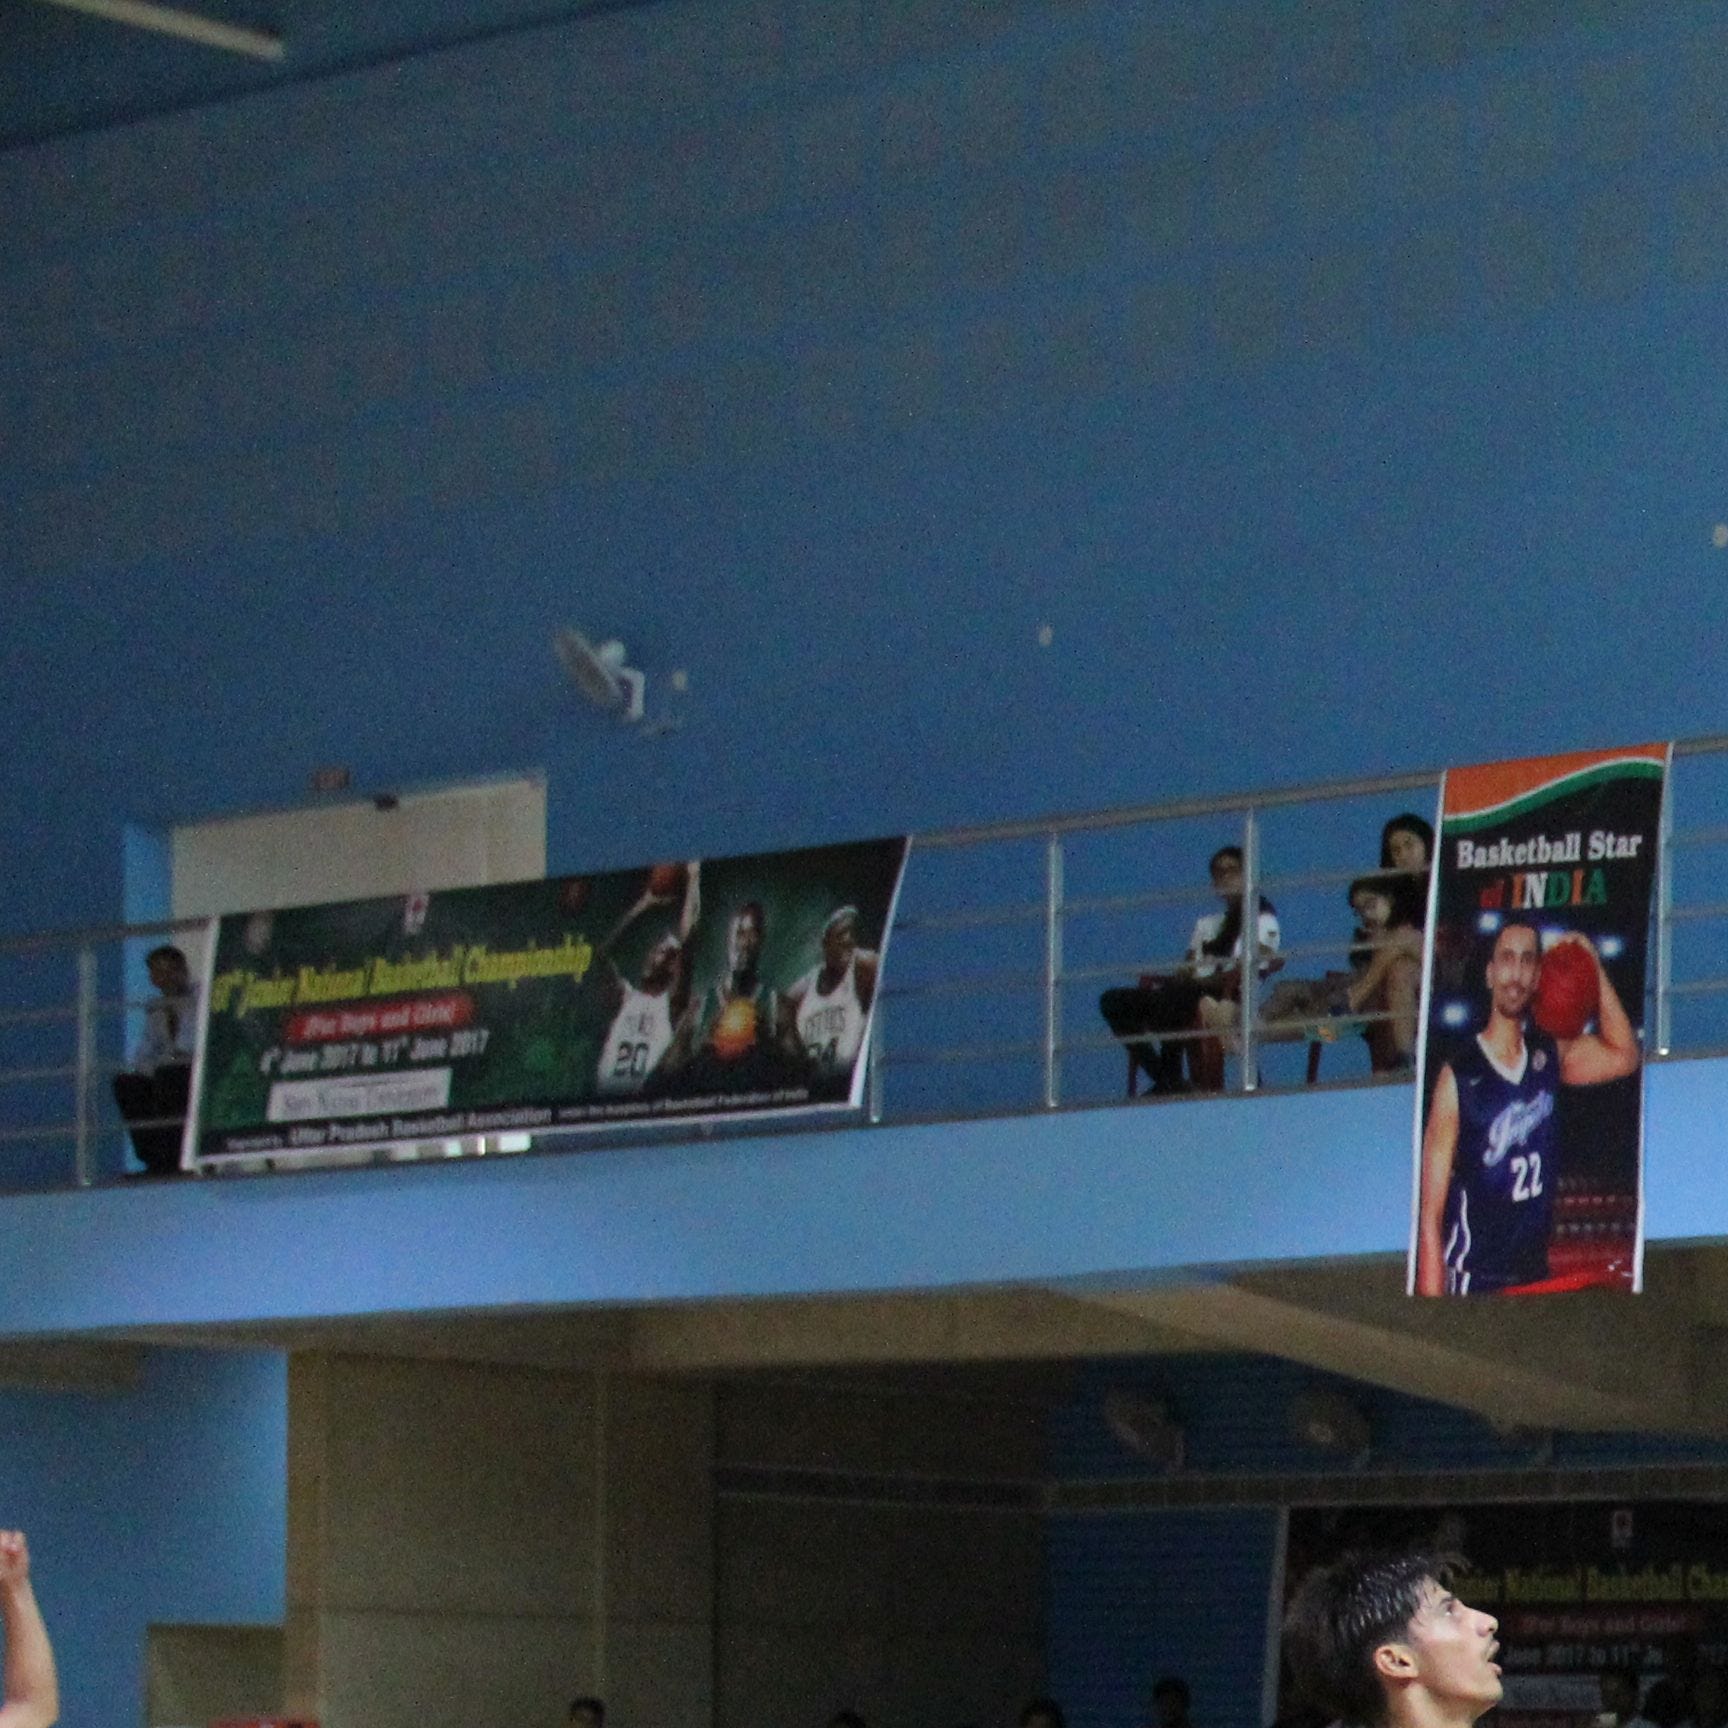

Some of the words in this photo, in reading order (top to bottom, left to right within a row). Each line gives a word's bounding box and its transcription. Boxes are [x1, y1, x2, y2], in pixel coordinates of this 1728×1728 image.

[1457, 833, 1581, 871] Basketball
[1588, 829, 1642, 862] Star
[1512, 867, 1607, 910] INDIA
[1510, 1151, 1543, 1203] 22
